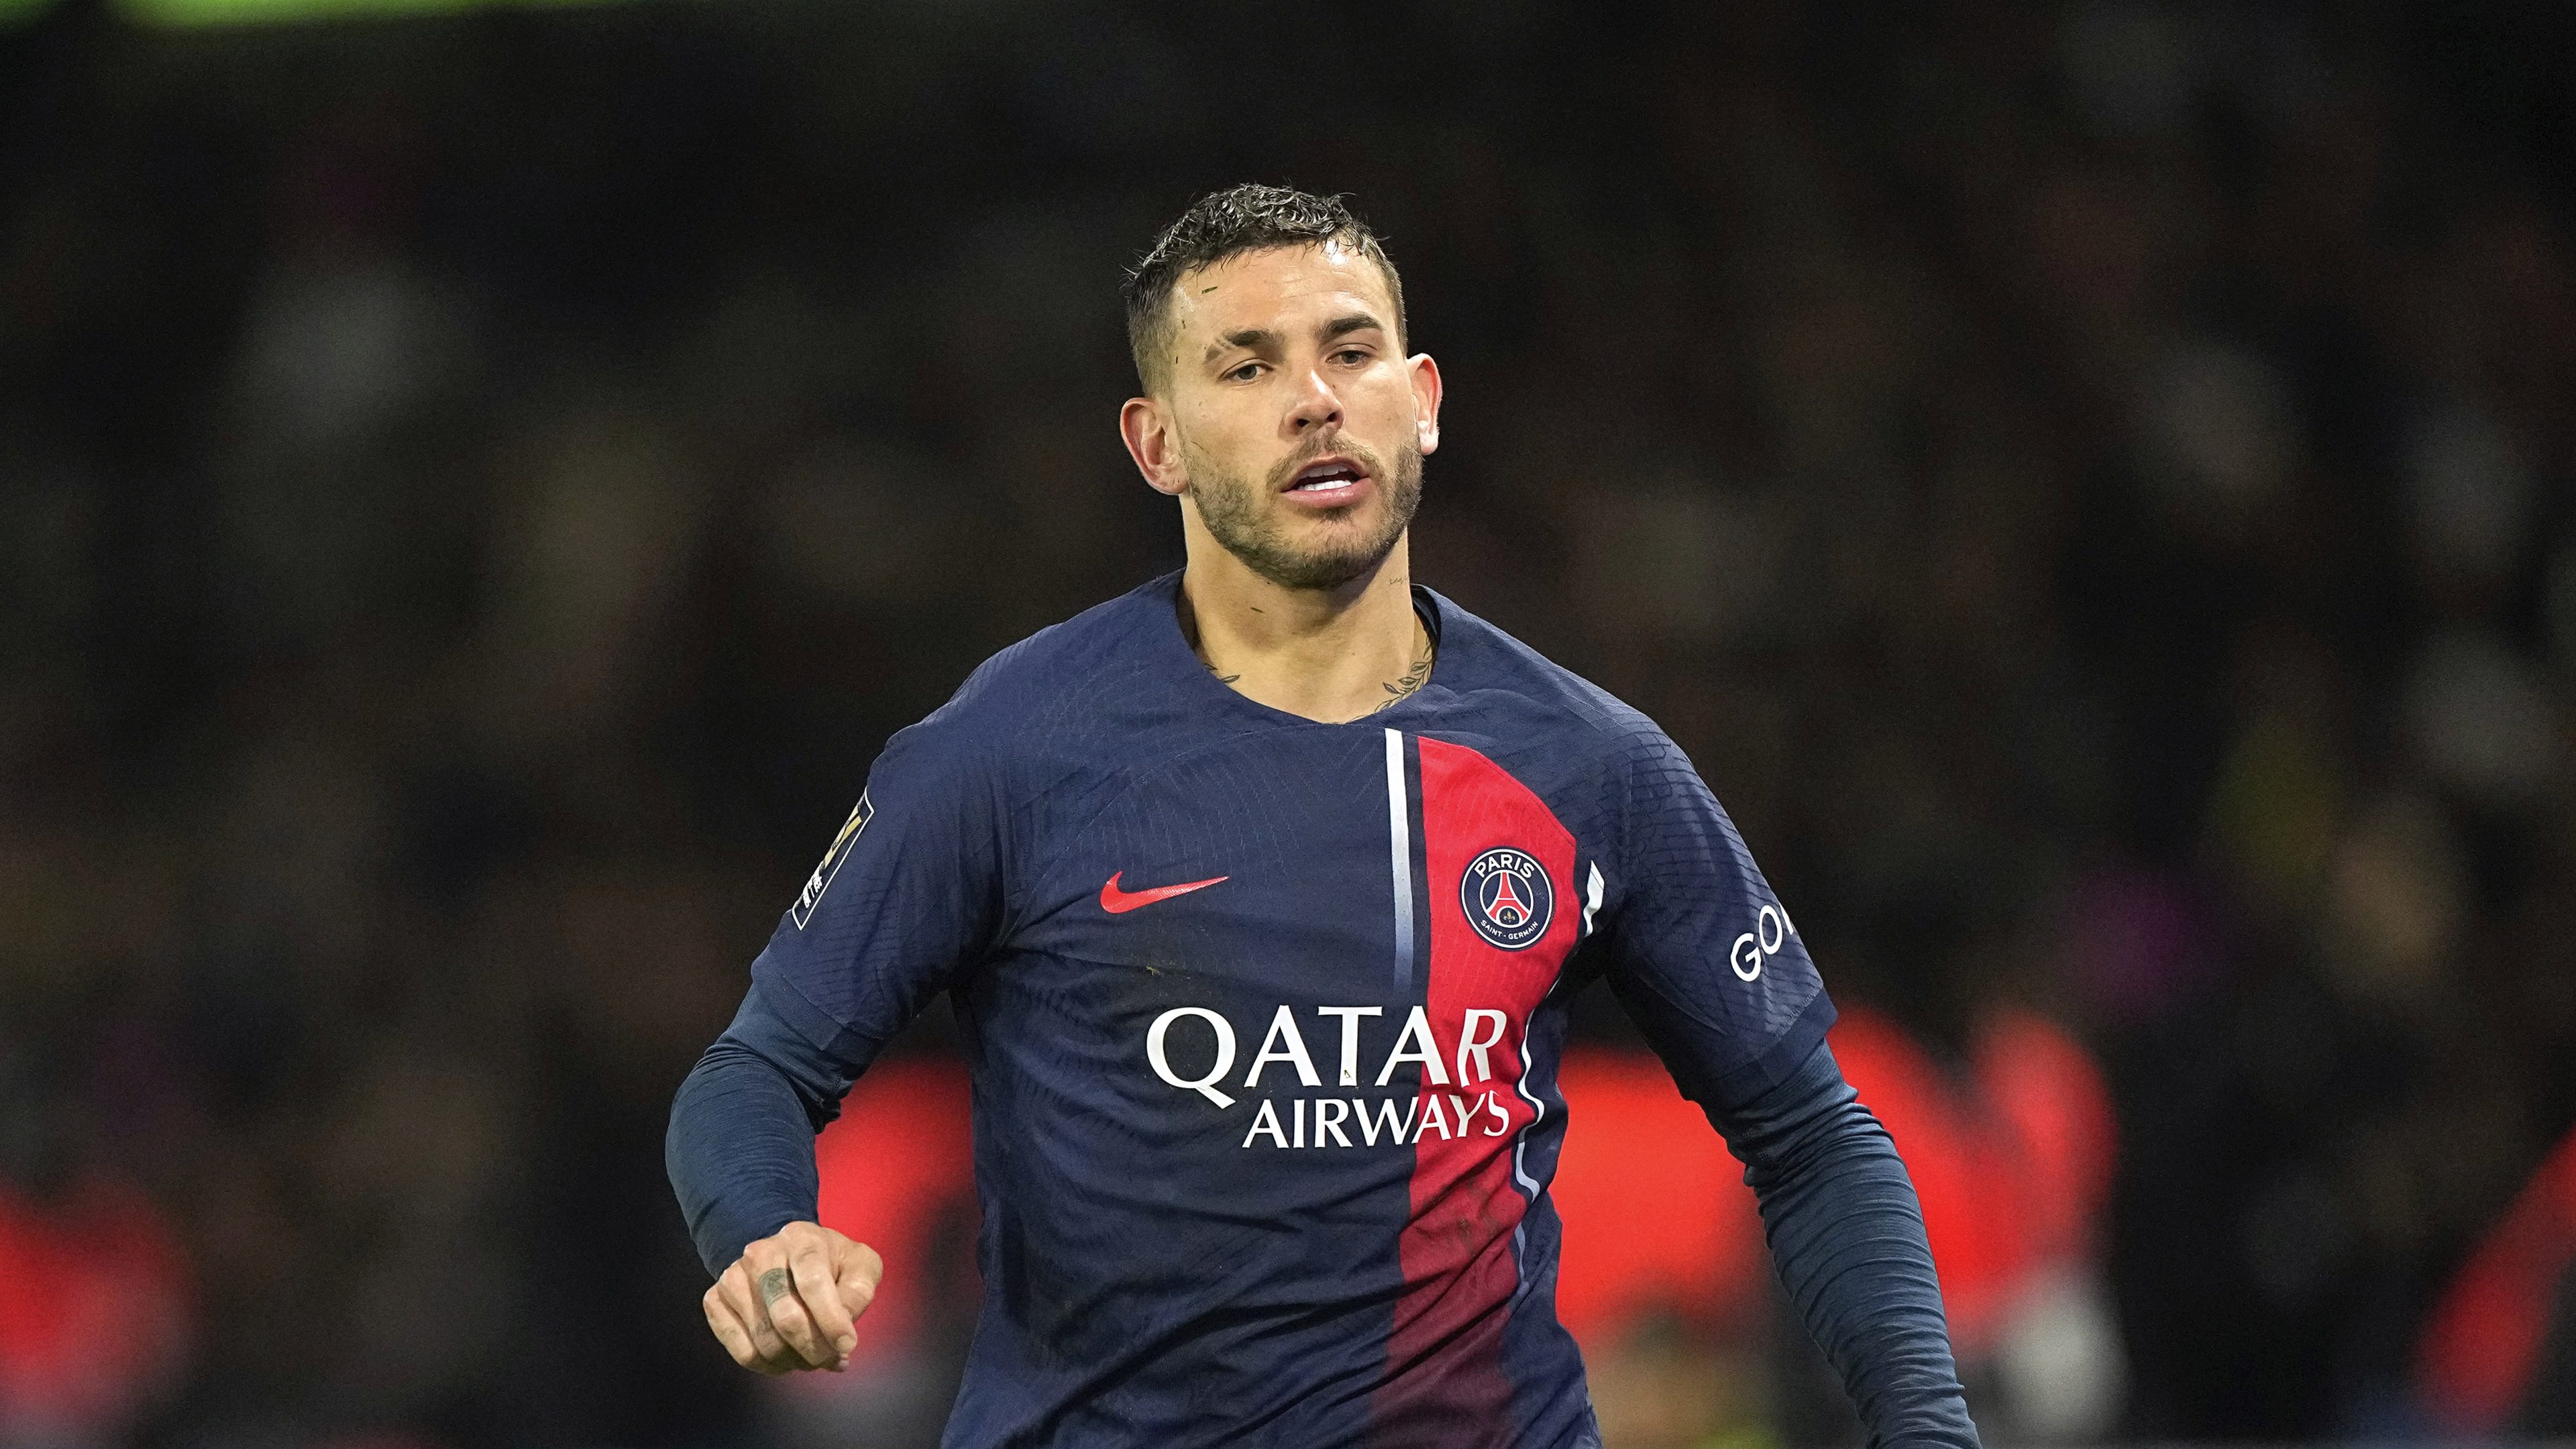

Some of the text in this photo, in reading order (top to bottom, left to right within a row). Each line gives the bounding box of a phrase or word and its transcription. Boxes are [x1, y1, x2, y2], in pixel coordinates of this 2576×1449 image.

[1474, 854, 1535, 879] PARIS
[1730, 902, 1794, 982] GO
[1146, 1004, 1507, 1110] QATAR
[1242, 1089, 1510, 1148] AIRWAYS
